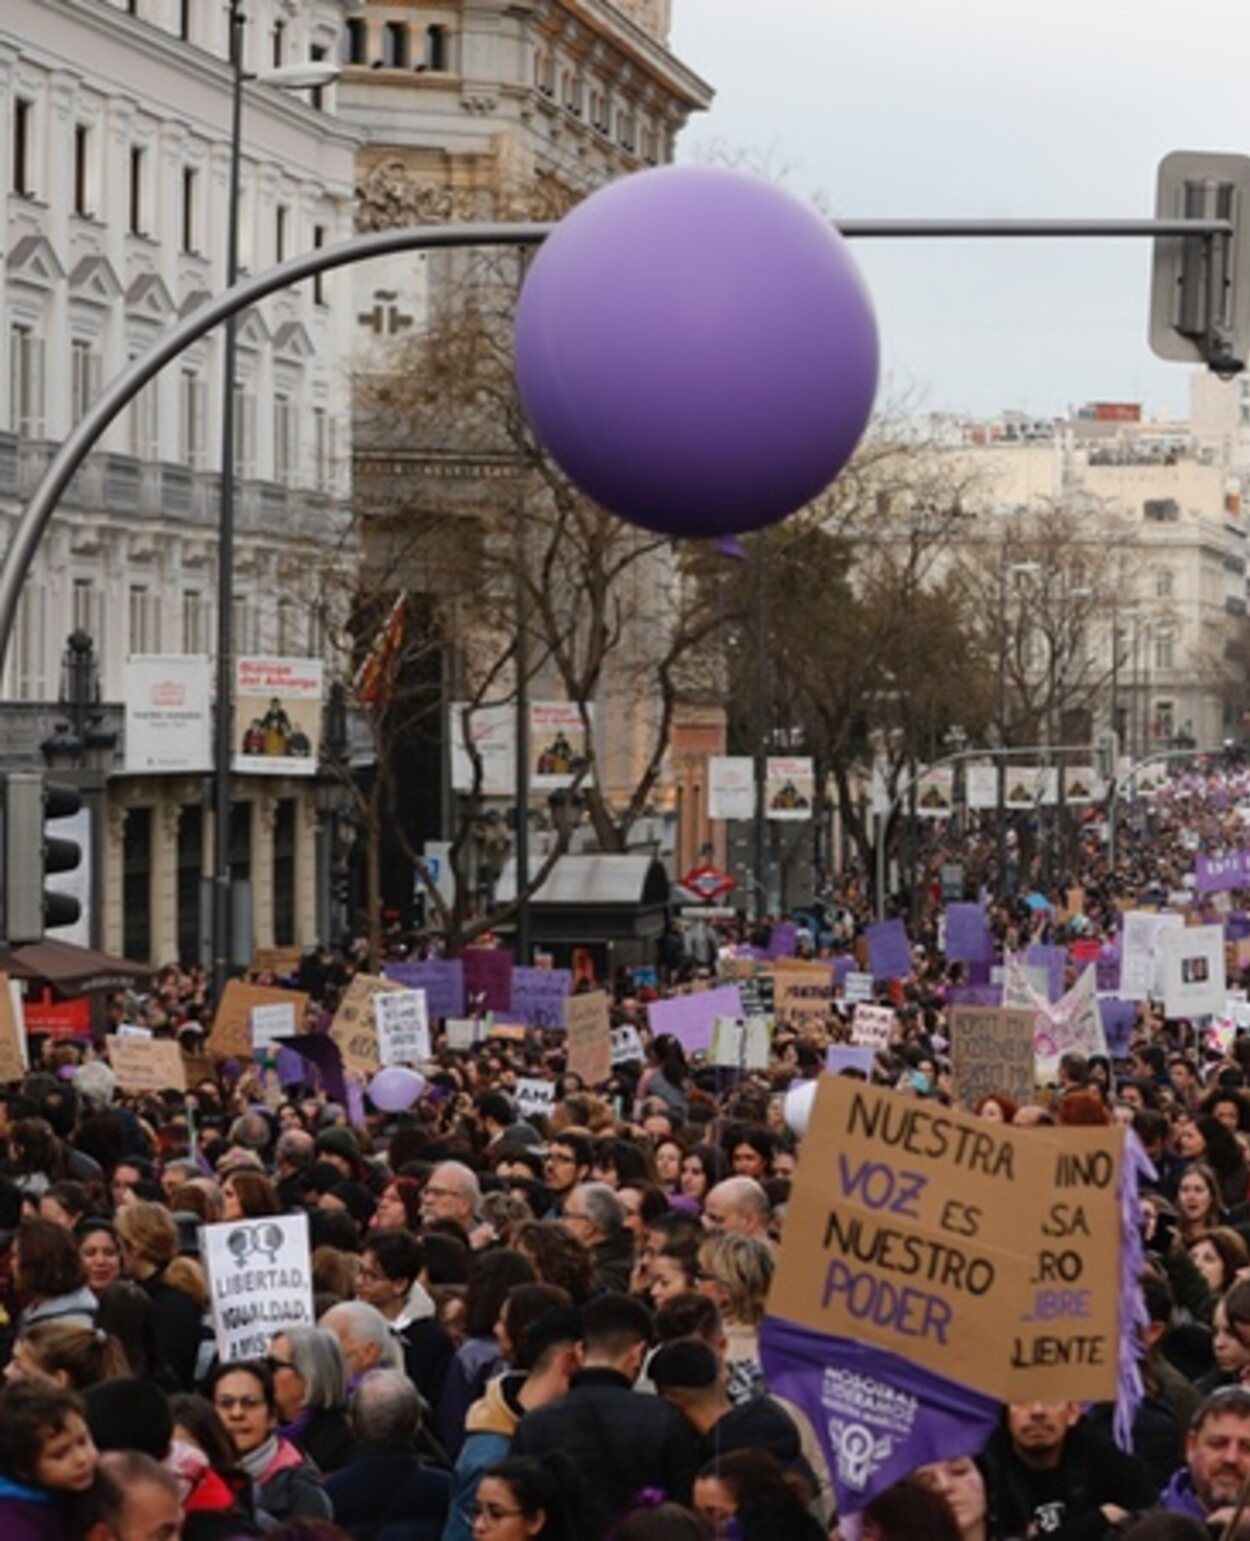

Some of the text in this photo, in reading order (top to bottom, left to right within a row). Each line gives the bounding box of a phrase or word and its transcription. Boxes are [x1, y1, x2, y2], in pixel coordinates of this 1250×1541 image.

[846, 1091, 1015, 1181] NUESTRA
[838, 1152, 985, 1237] VOZ ES
[1041, 1202, 1091, 1238] SA
[216, 1268, 308, 1299] LIBERTAD,
[821, 1212, 996, 1297] NUESTRO
[1030, 1249, 1083, 1285] RO
[820, 1260, 954, 1346] PODER
[230, 1331, 270, 1359] AMIS
